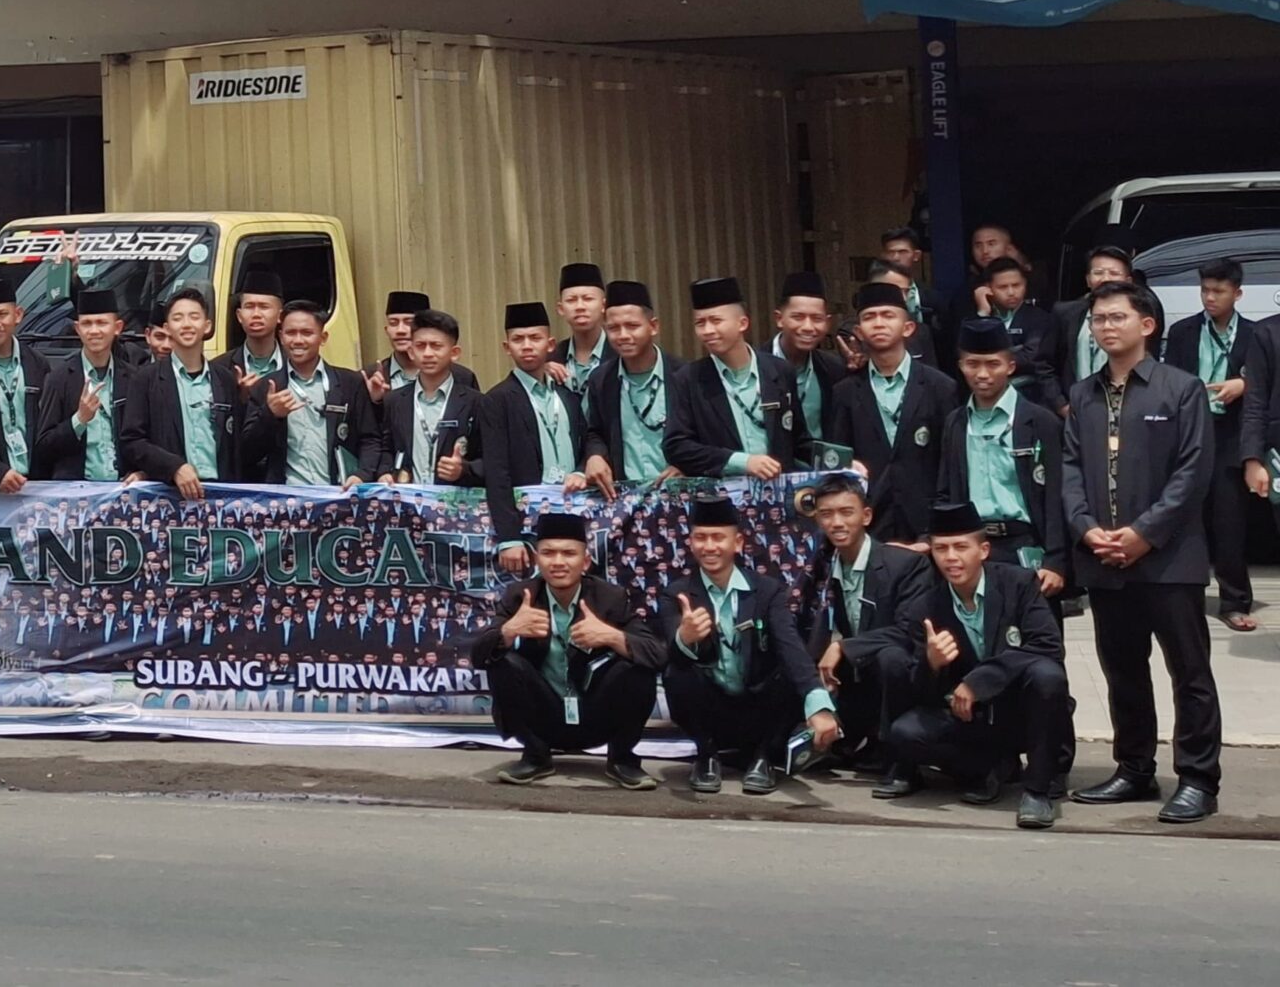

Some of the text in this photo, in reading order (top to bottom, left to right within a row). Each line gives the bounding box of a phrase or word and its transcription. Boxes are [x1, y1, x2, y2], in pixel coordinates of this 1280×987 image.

[196, 74, 303, 100] BRIDESONE
[930, 61, 949, 139] EAGLE LIFT
[136, 659, 264, 688] SUBANG
[297, 663, 490, 693] PURWAKART
